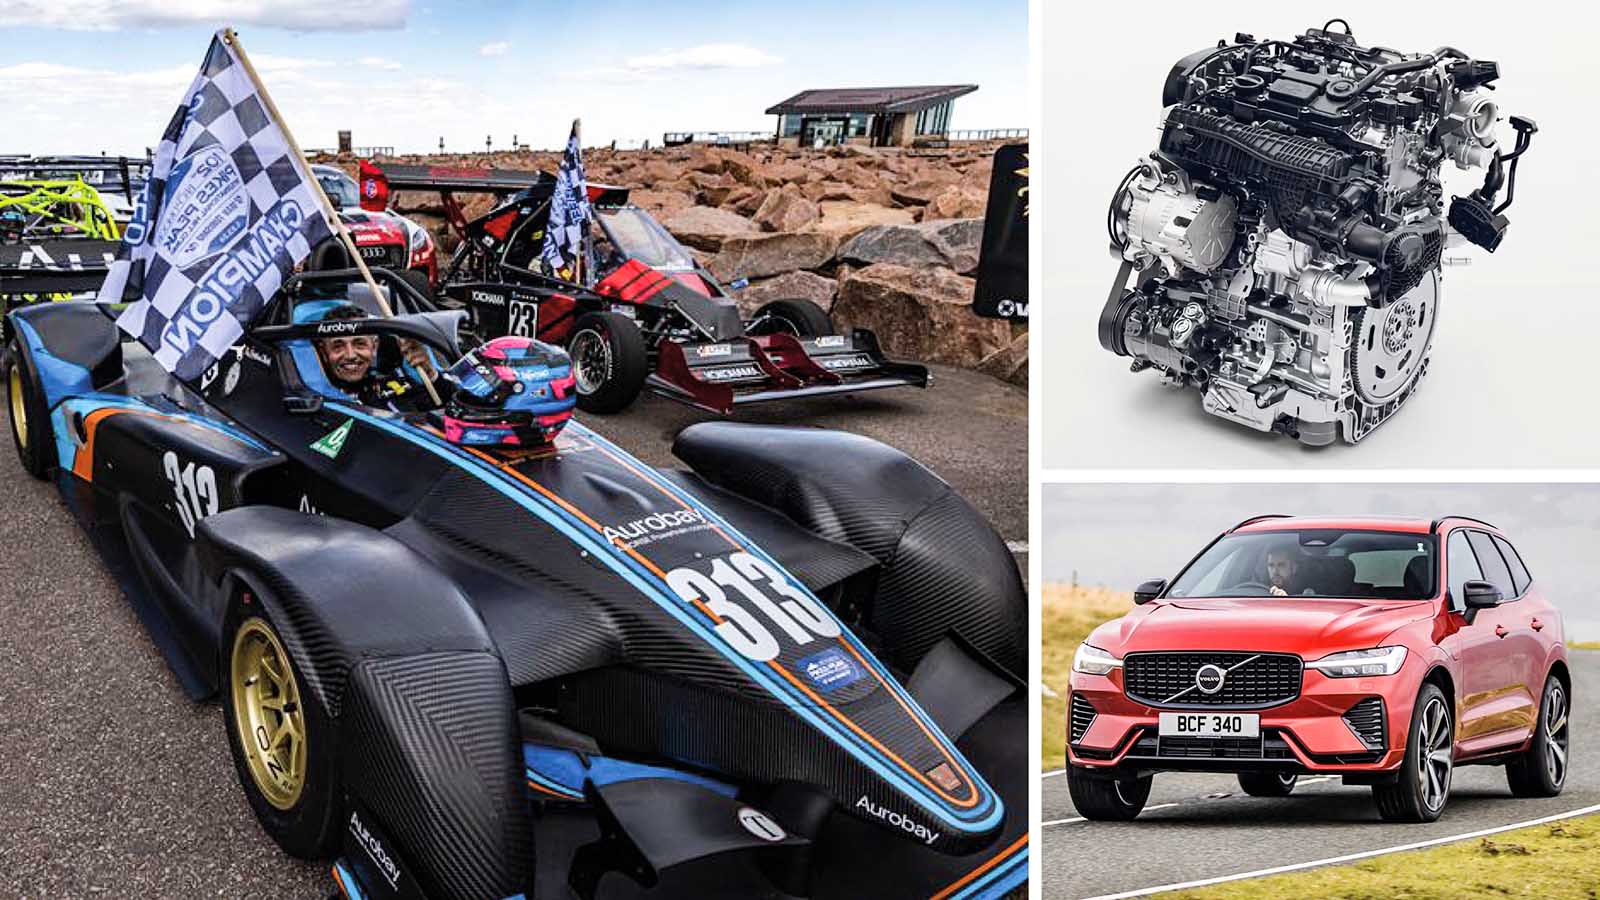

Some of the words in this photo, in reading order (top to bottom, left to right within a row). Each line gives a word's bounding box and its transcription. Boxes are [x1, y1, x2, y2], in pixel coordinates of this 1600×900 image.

[318, 321, 358, 333] Aurobay
[511, 302, 536, 338] 23
[163, 450, 219, 539] 313
[603, 509, 707, 545] Aurobay
[665, 551, 841, 661] 313
[1177, 715, 1207, 732] BCF
[1212, 716, 1242, 733] 340
[856, 795, 940, 845] Aurobay
[351, 811, 400, 882] Aurobay
